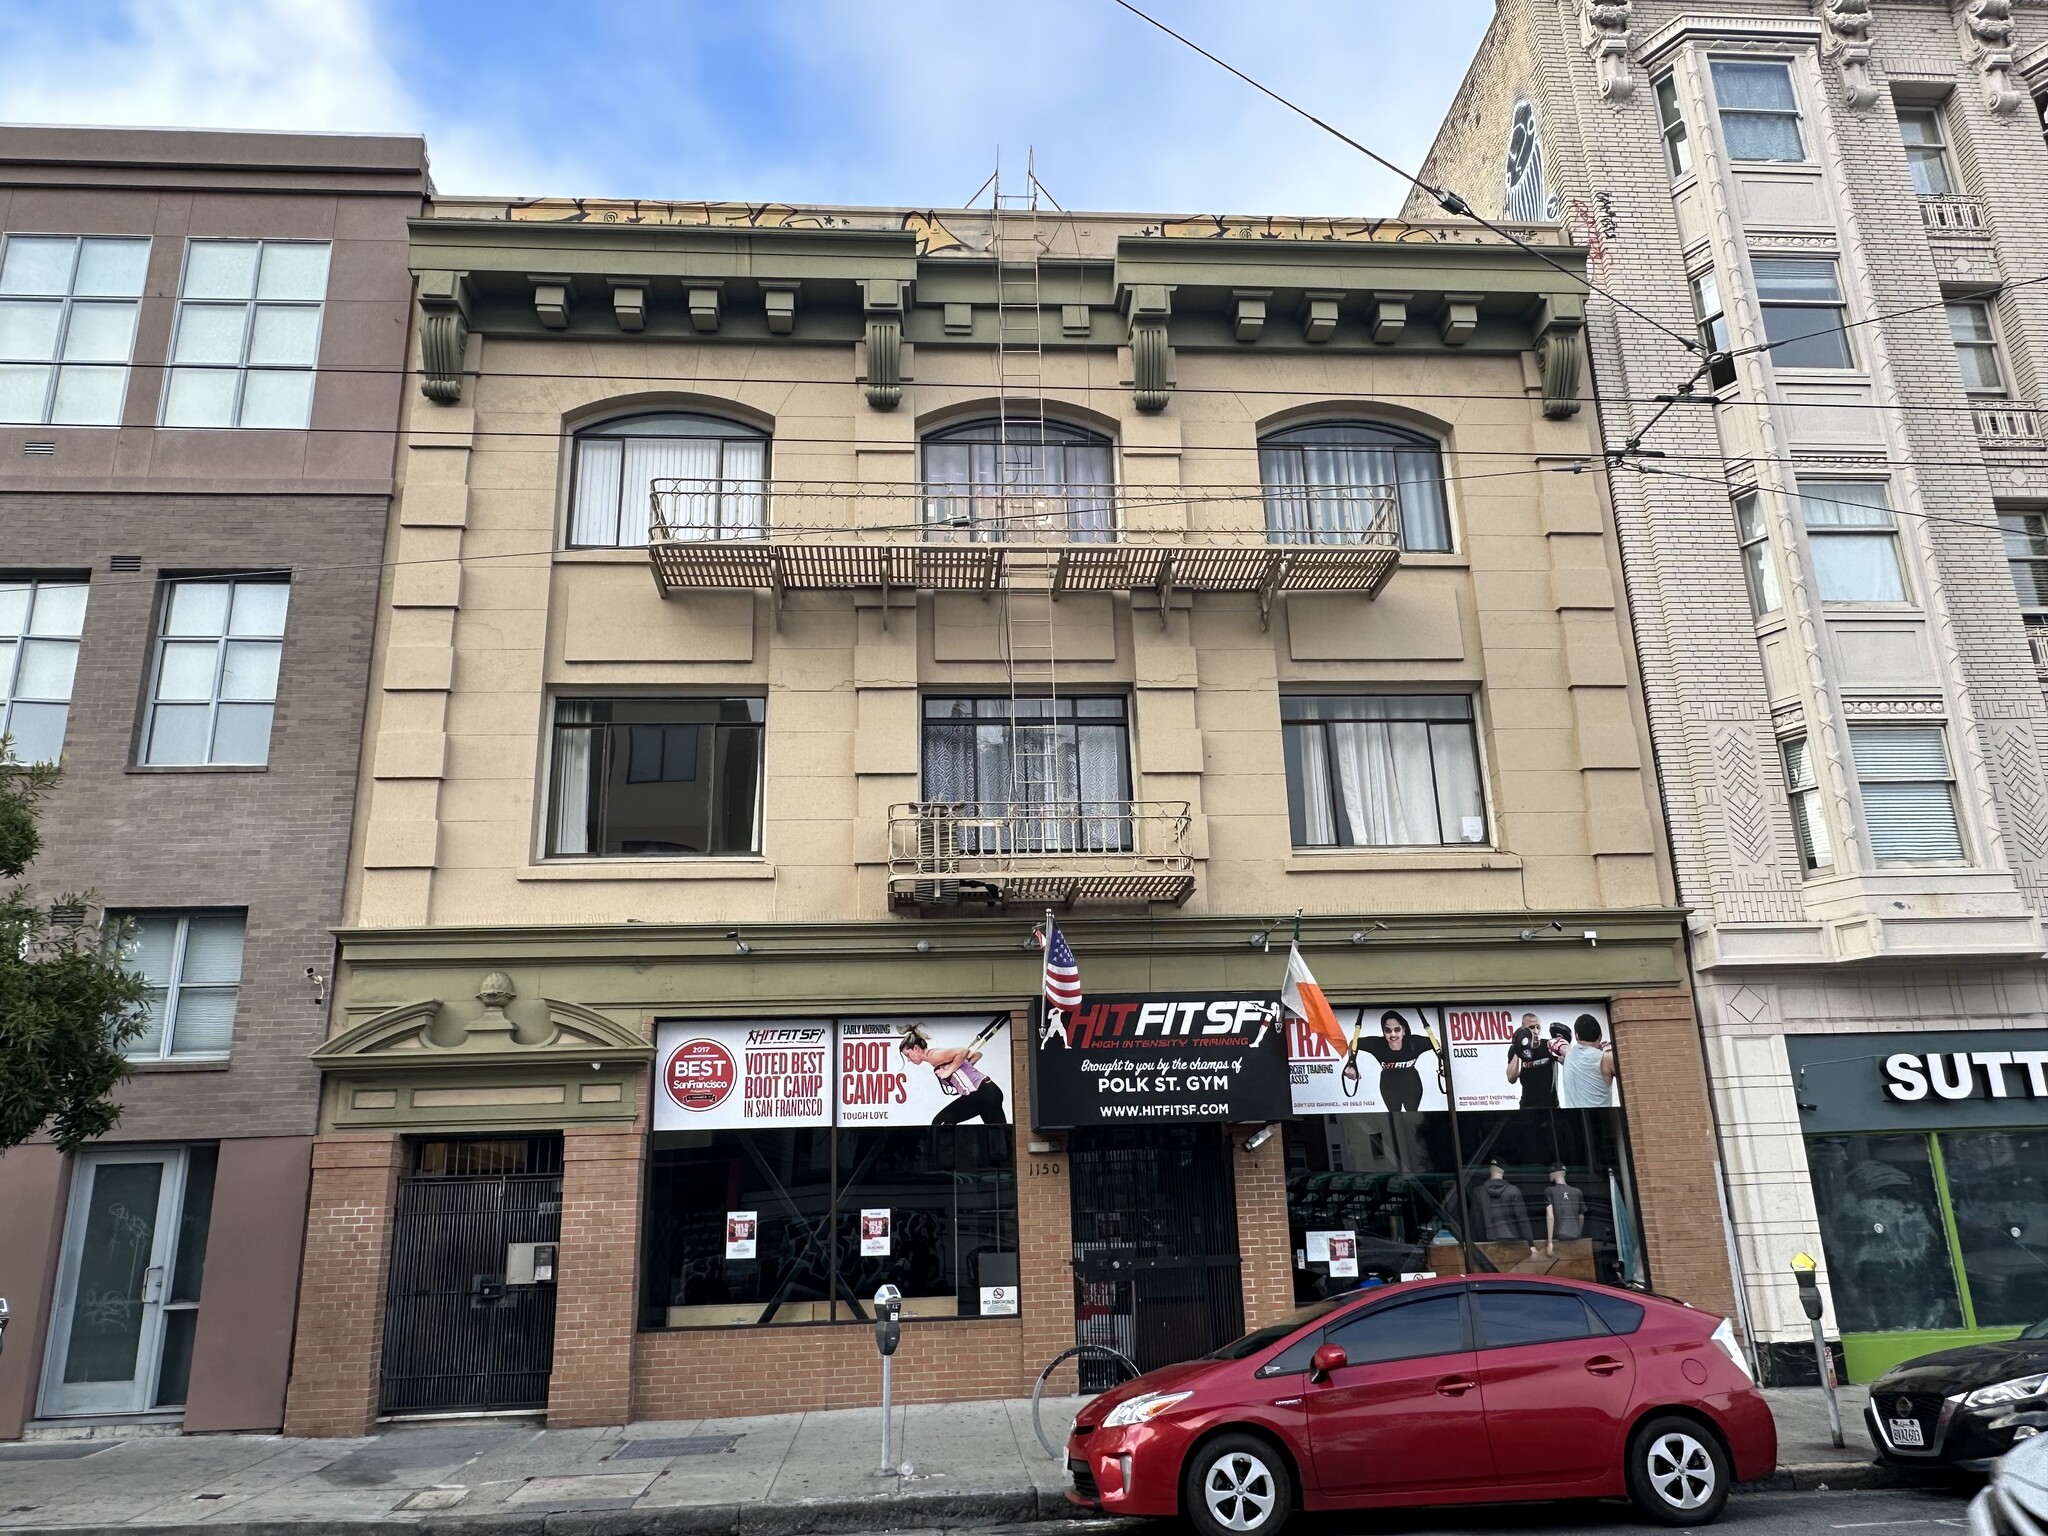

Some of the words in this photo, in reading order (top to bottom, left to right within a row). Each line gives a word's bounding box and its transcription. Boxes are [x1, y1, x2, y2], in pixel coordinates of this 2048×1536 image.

[843, 1024, 861, 1034] EARLY
[862, 1023, 891, 1034] MORNING
[1449, 1011, 1514, 1041] BOXING
[1091, 1040, 1120, 1048] HIGH
[1122, 1039, 1188, 1048] INTENSITY
[1192, 1037, 1249, 1046] TRAINING
[1285, 1017, 1331, 1057] TRX
[745, 1053, 788, 1075] VOTED
[791, 1051, 825, 1074] BEST
[842, 1042, 891, 1073] BOOT
[1081, 1058, 1123, 1077] Brought
[1124, 1060, 1135, 1071] to
[1134, 1062, 1155, 1076] you
[1156, 1058, 1170, 1076] by
[1171, 1057, 1188, 1070] the
[1189, 1057, 1230, 1072] champs
[1231, 1057, 1243, 1074] of
[674, 1060, 727, 1077] BEST
[1885, 1051, 2048, 1100] SUTT
[744, 1076, 781, 1099] BOOT
[783, 1075, 823, 1098] CAMP
[842, 1073, 907, 1105] CAMPS
[1098, 1077, 1150, 1093] POLK
[1154, 1076, 1181, 1092] ST.
[1186, 1075, 1229, 1091] GYM
[744, 1101, 753, 1118] IN
[755, 1100, 773, 1117] SAN
[775, 1099, 822, 1117] FRANCISCO
[842, 1112, 868, 1120] TOUGH
[869, 1111, 889, 1119] LOVE
[1100, 1103, 1229, 1117] WWW.HITFITSF.COM
[1029, 1163, 1060, 1176] 1150
